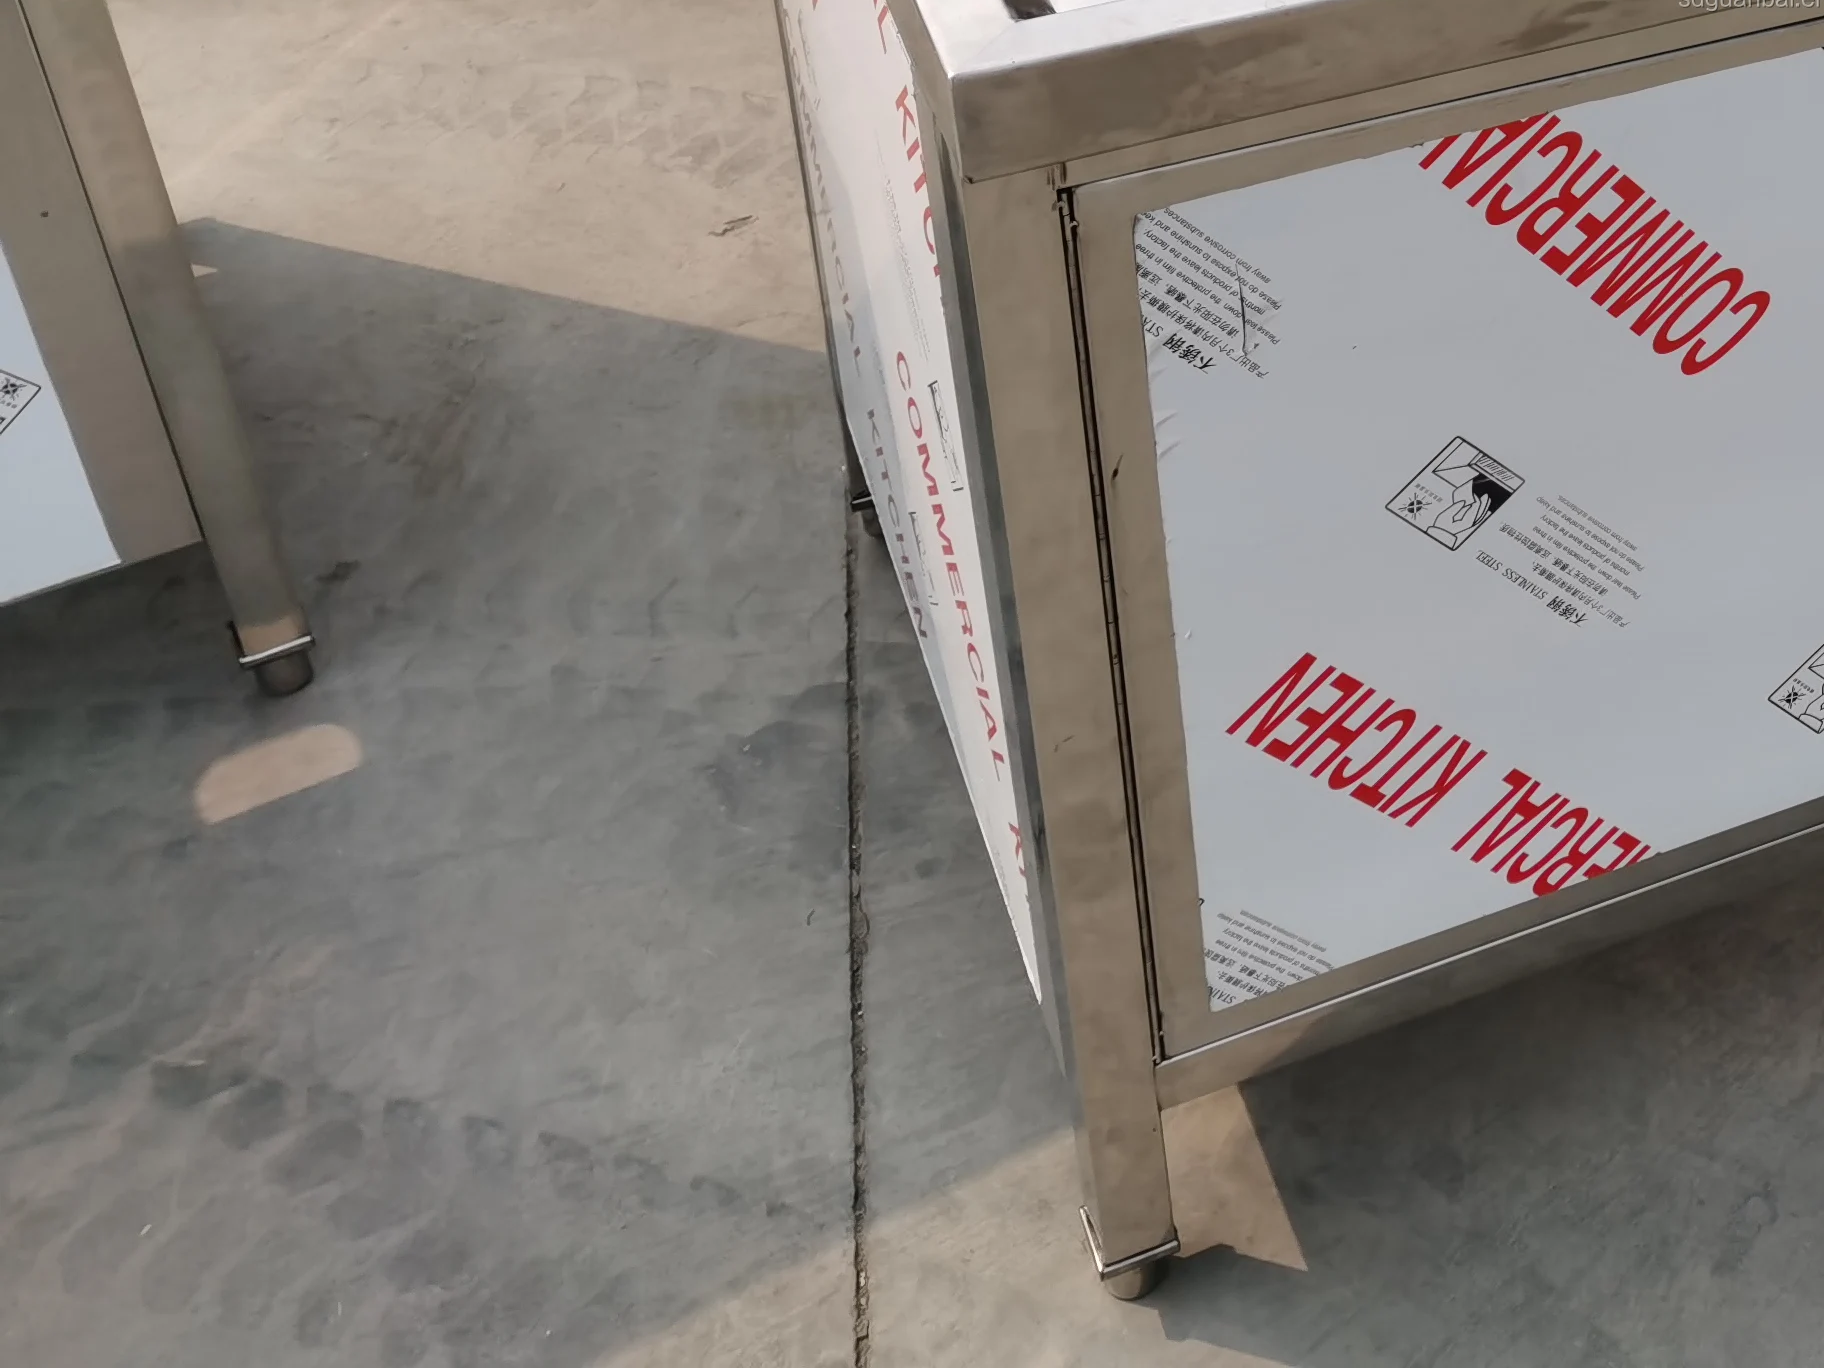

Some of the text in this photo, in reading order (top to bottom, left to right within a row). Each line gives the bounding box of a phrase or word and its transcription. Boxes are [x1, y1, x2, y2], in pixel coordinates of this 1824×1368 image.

[895, 84, 942, 277] KITC
[1143, 229, 1170, 250] factory.
[1135, 243, 1157, 260] three
[1169, 247, 1182, 259] the
[1204, 236, 1236, 259] corrosive
[1141, 212, 1282, 310] Please do not expose to sunshine and kee
[1154, 256, 1163, 265] in
[1162, 261, 1176, 274] film
[1181, 256, 1202, 273] leave
[1235, 258, 1252, 272] from
[1176, 271, 1212, 295] protective
[1201, 268, 1233, 291] products
[1251, 268, 1271, 283] away
[1209, 294, 1222, 304] the
[1239, 296, 1266, 315] months
[1223, 303, 1244, 318] down
[1256, 326, 1280, 345] Please
[1141, 314, 1216, 374] 不锈钢 STA
[1536, 496, 1551, 509] keep
[1548, 505, 1562, 515] and
[1560, 513, 1586, 531] sunshine
[1532, 526, 1548, 538] three
[1558, 527, 1569, 536] the
[1610, 532, 1624, 543] from
[1552, 539, 1564, 549] film
[1568, 533, 1584, 546] leave
[1591, 533, 1611, 548] expose
[1562, 546, 1590, 564] protective
[1582, 543, 1607, 560] products
[896, 351, 1005, 782] COMMERCIAL
[1587, 562, 1597, 570] the
[1610, 561, 1630, 576] months
[1625, 557, 1645, 572] Please
[1597, 568, 1612, 580] down
[1476, 550, 1588, 627] 不锈钢 STAINLESS STEEL
[1622, 585, 1641, 600] Please
[1225, 652, 1652, 898] ERCIAL KITCHEN
